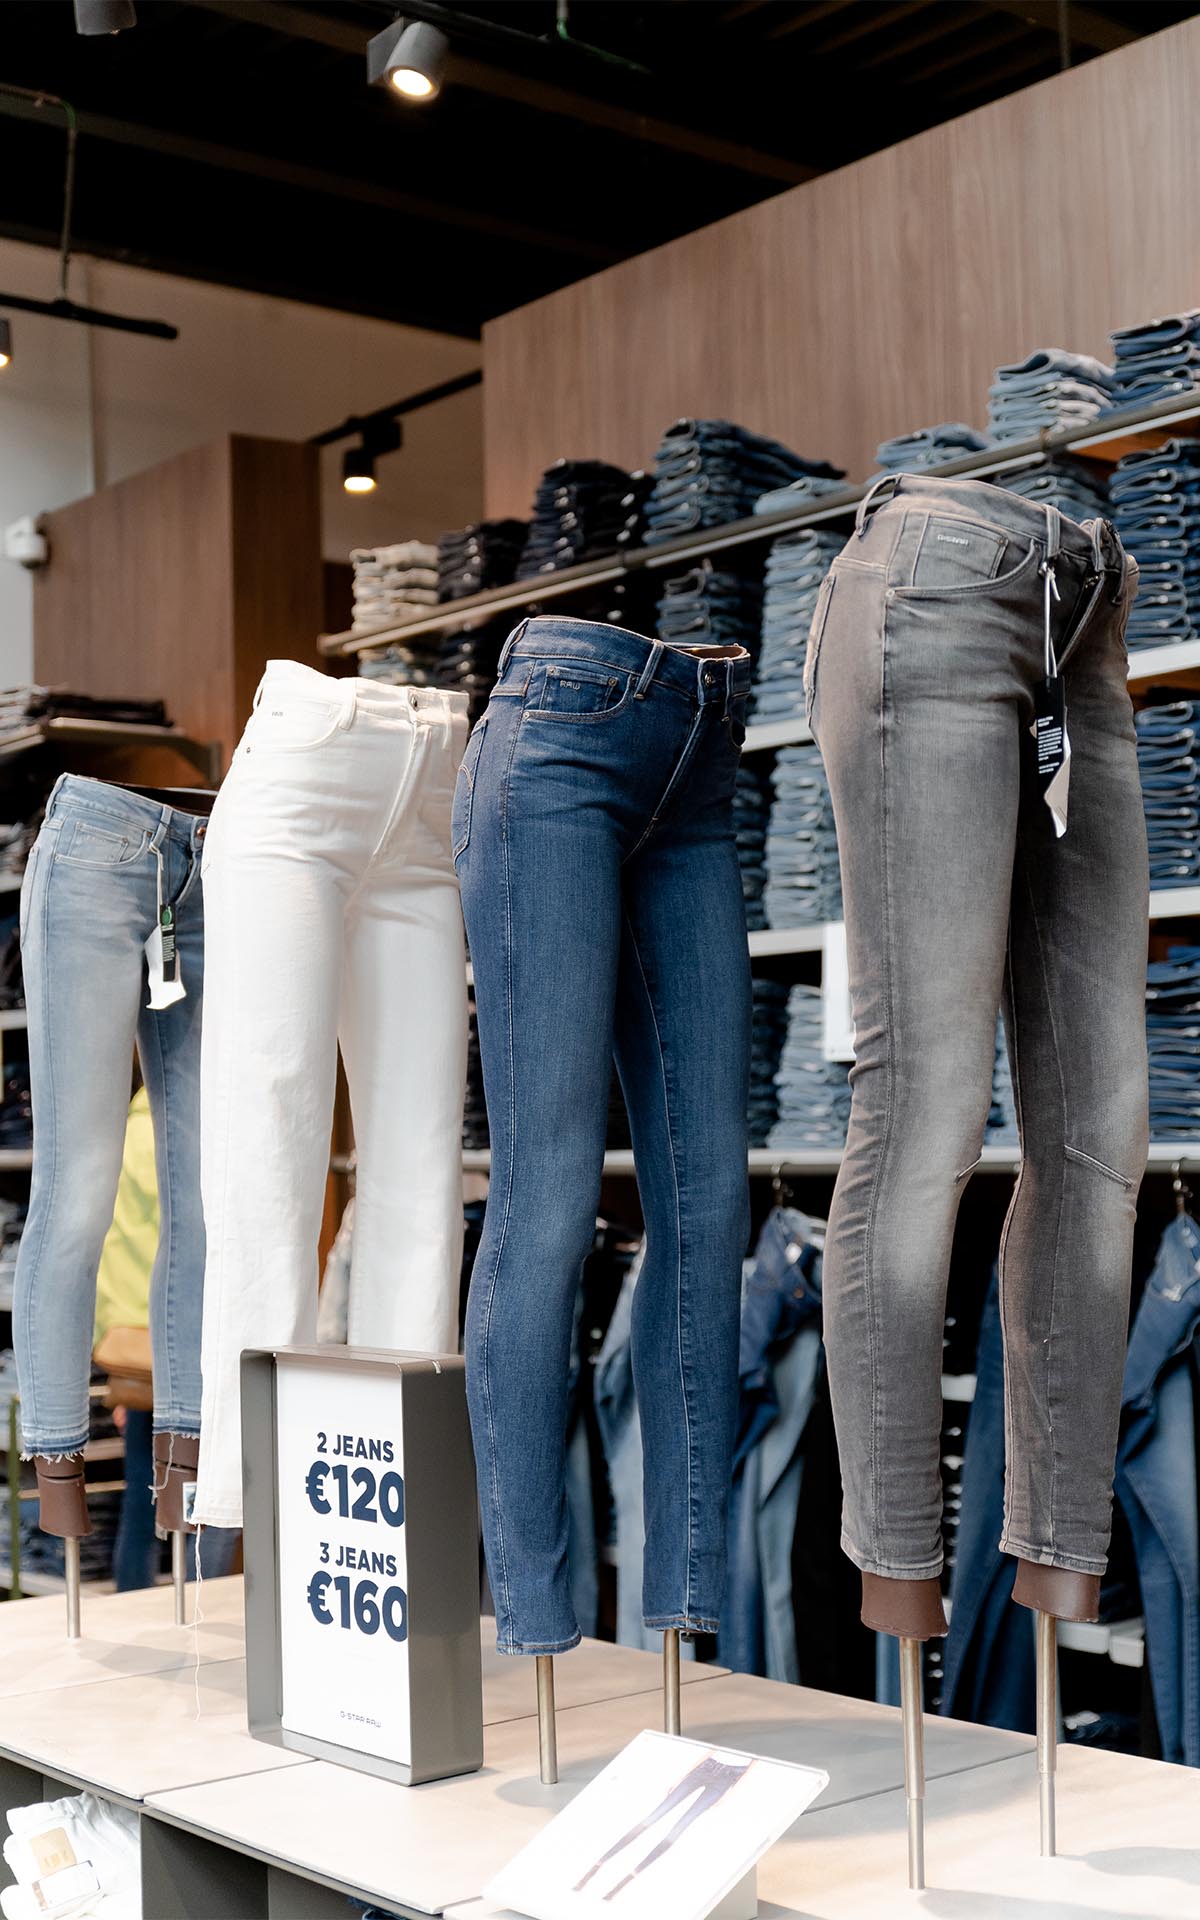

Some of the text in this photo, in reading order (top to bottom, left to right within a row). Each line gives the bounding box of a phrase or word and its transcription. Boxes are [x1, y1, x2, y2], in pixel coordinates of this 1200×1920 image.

[560, 680, 580, 690] RAW
[317, 1431, 394, 1463] 2 JEANS
[305, 1460, 405, 1527] €120
[320, 1541, 397, 1577] 3 JEANS
[307, 1570, 407, 1642] €160
